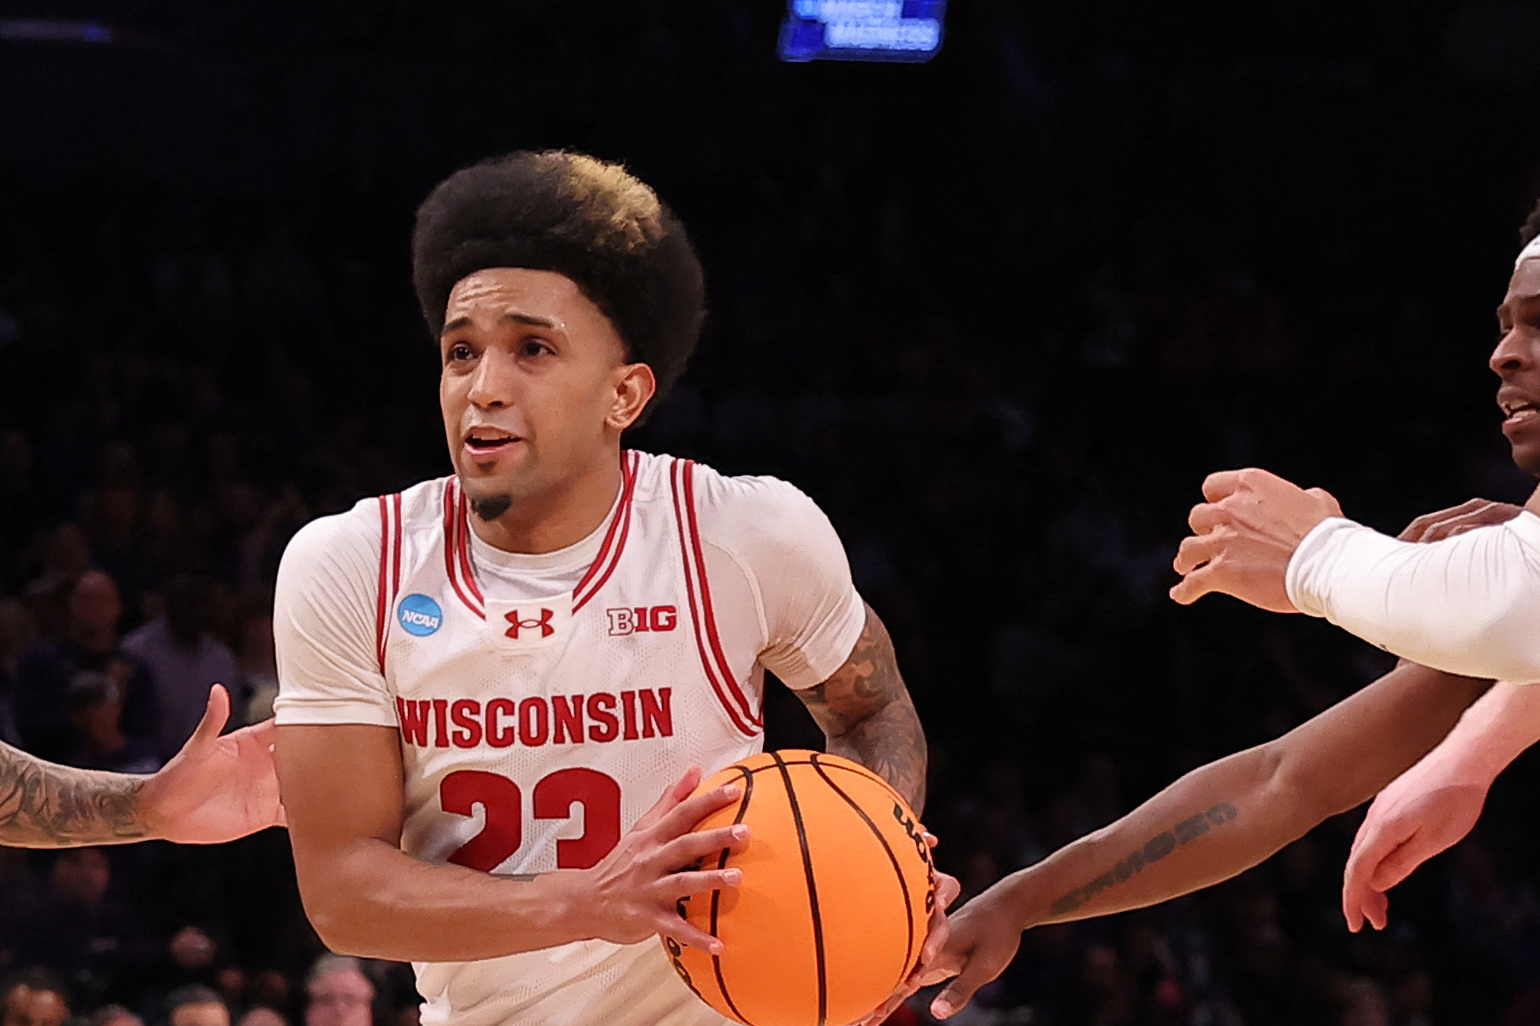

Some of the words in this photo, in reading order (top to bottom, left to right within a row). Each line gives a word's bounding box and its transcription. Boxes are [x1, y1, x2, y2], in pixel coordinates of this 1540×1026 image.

[401, 612, 440, 630] NCAA
[606, 605, 678, 636] BIG
[397, 687, 674, 749] WISCONSIN
[439, 767, 622, 874] 23
